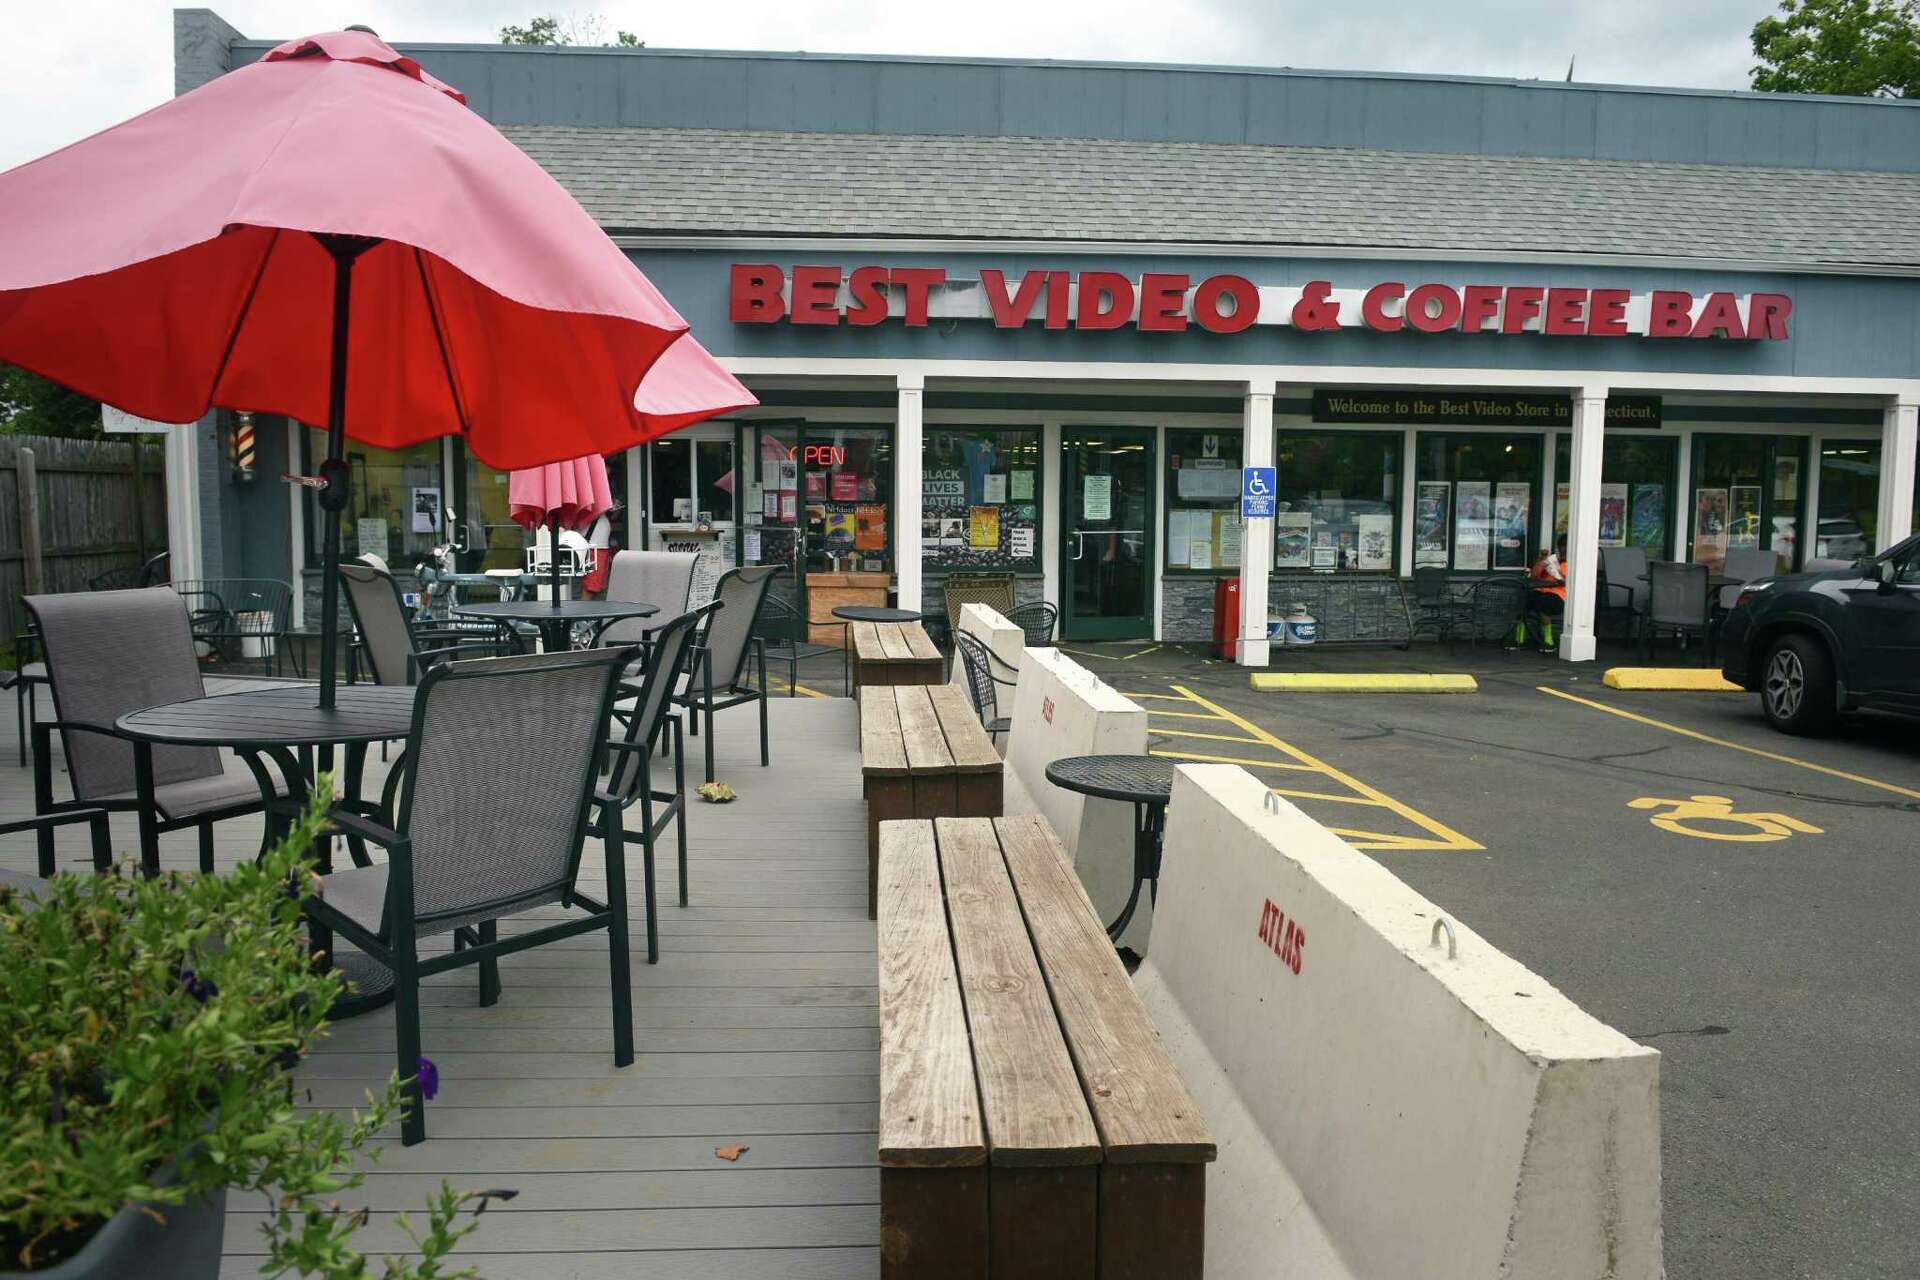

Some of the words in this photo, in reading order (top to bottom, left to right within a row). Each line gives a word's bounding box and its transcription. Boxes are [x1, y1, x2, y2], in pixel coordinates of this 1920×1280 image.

[729, 264, 946, 327] BEST
[980, 269, 1261, 334] VIDEO
[1291, 281, 1342, 333] &
[1361, 281, 1631, 337] COFFEE
[1648, 290, 1794, 340] BAR
[1327, 398, 1391, 414] Welcome
[1395, 401, 1409, 415] to
[1413, 400, 1435, 415] the
[1440, 400, 1470, 415] Best
[1473, 400, 1512, 416] Video
[1515, 401, 1550, 417] Store
[1554, 403, 1569, 417] in
[1604, 404, 1656, 418] ecticut.
[922, 483, 960, 493] LIVES
[1258, 898, 1305, 975] ATLAS
